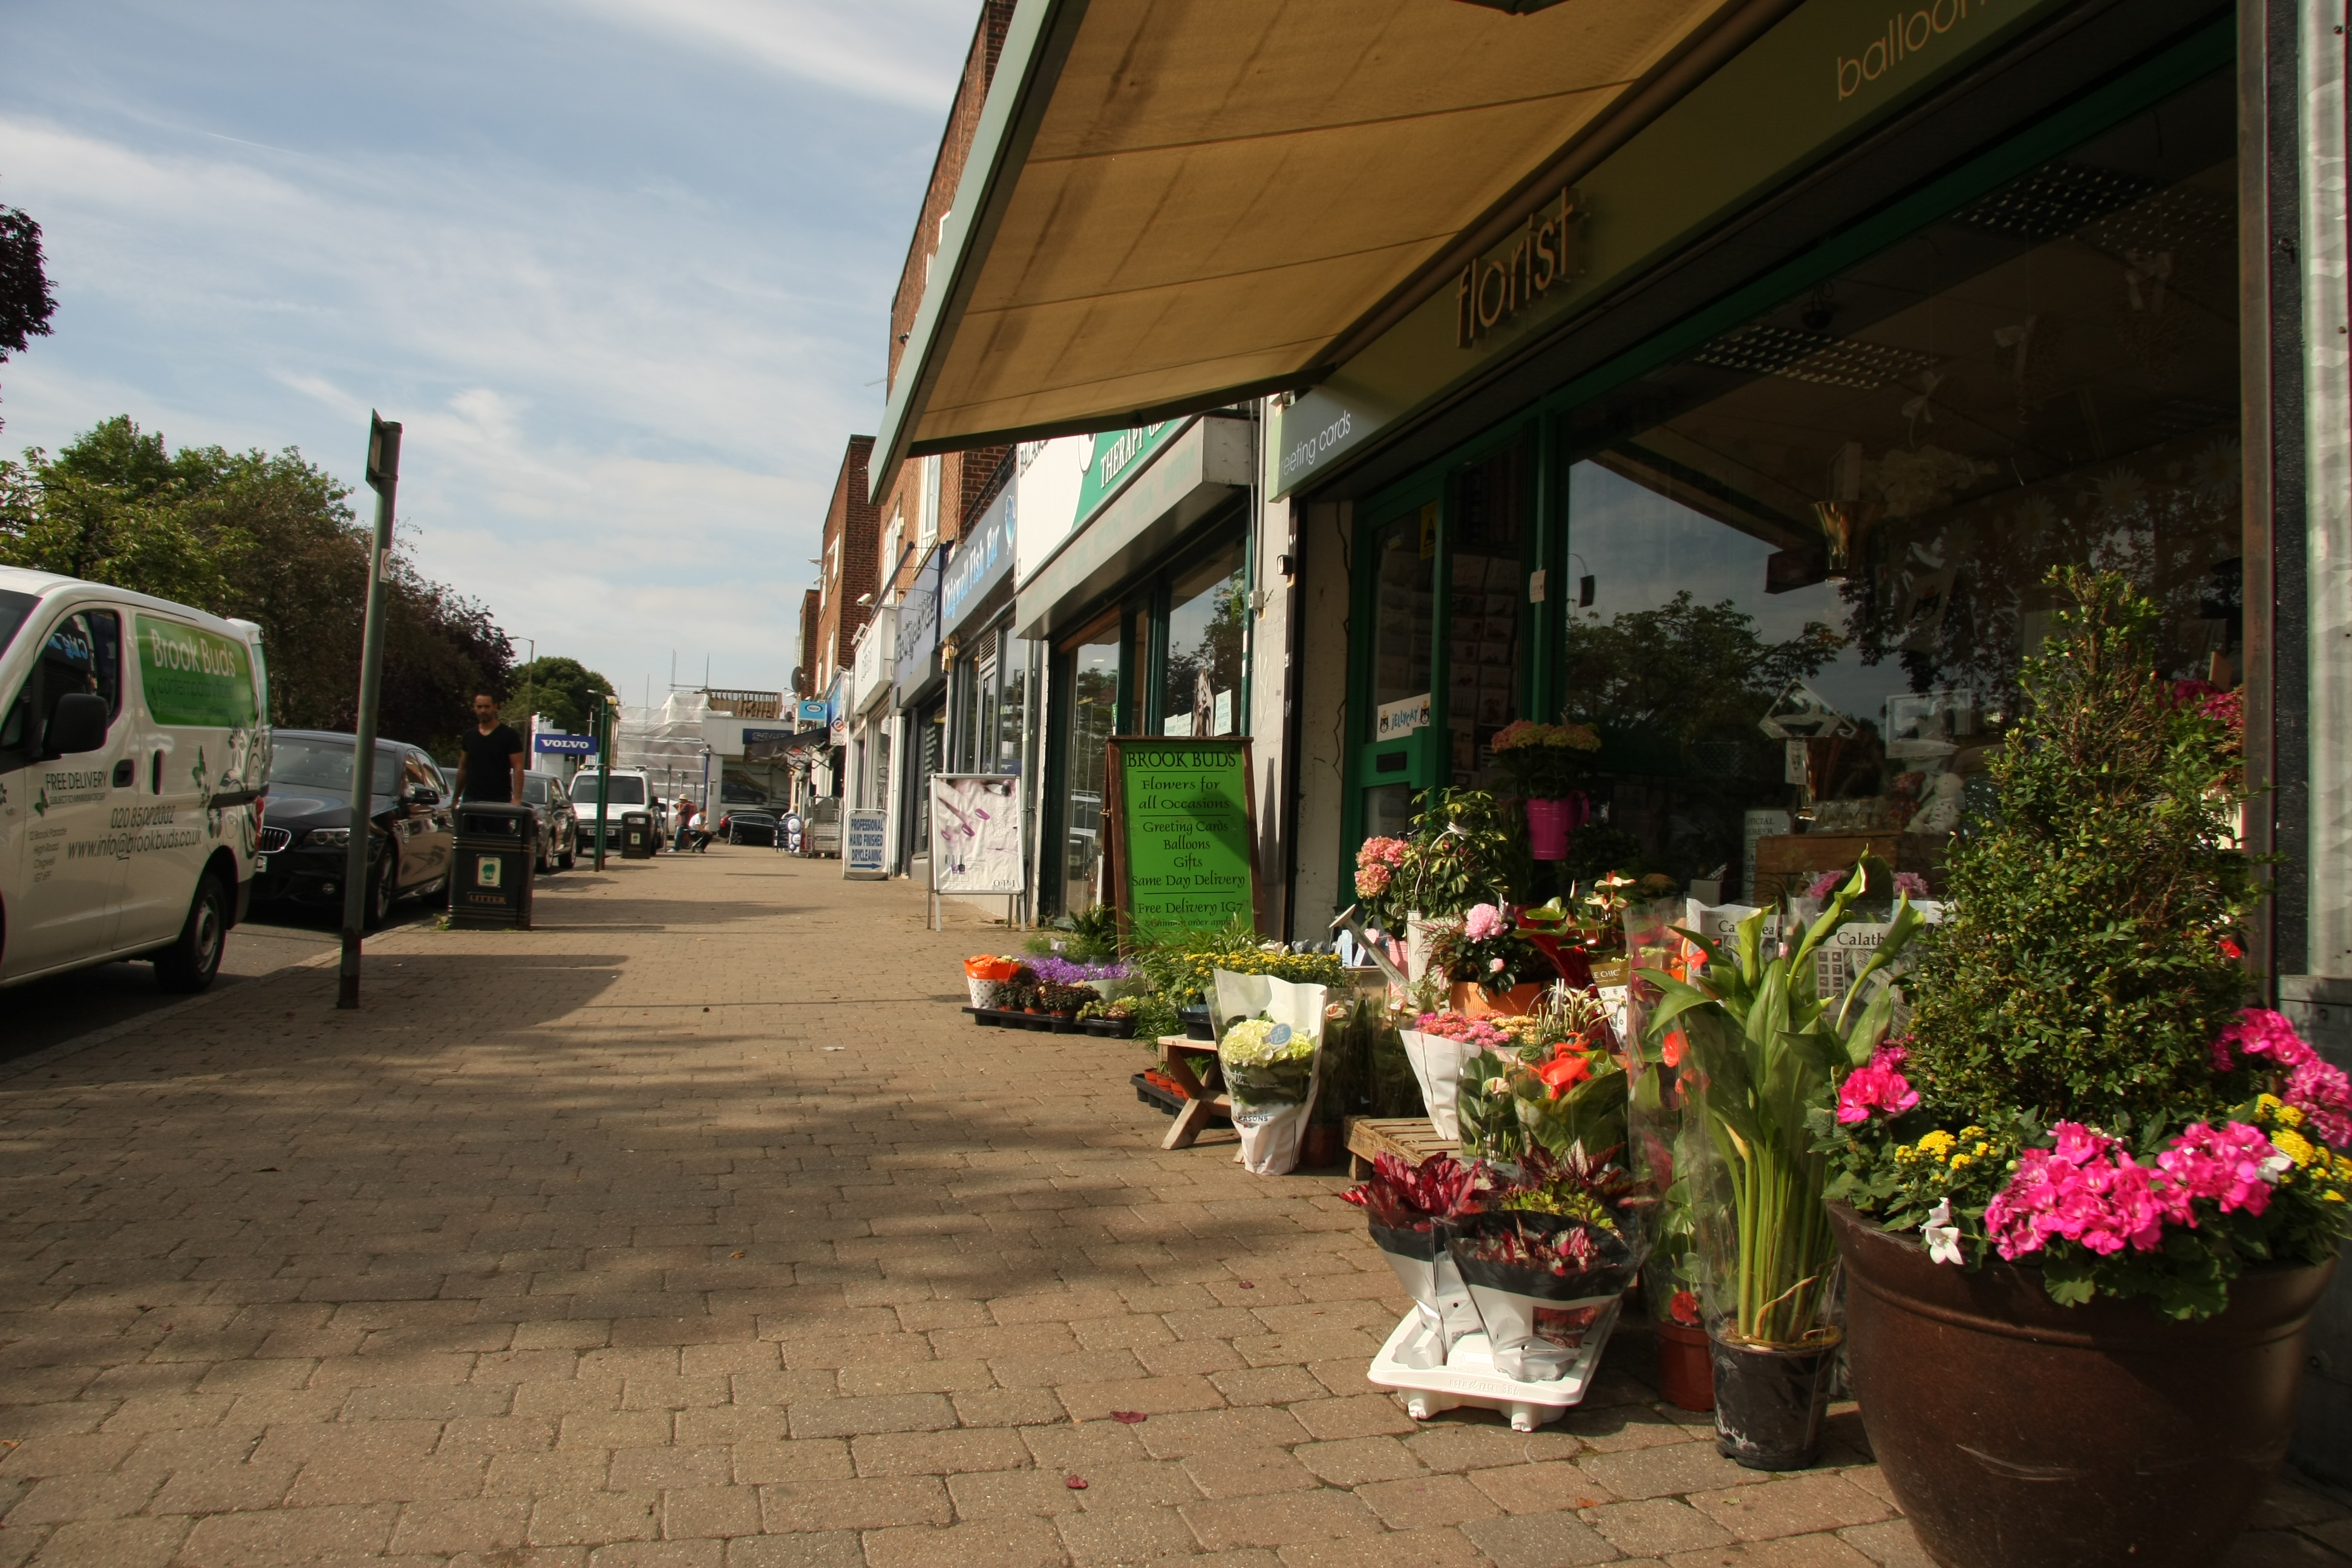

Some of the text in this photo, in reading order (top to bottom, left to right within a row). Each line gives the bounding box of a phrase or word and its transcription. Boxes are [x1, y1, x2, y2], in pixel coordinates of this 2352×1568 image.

[1837, 0, 1986, 102] balloo
[1455, 187, 1573, 348] florist
[1100, 427, 1144, 489] THERAPY
[1273, 410, 1351, 488] greeting cards
[943, 525, 1000, 619] Chigwell Fish Bar
[151, 628, 236, 678] Brook Buds
[541, 739, 589, 749] VOLVO
[1126, 751, 1236, 768] BROOK BUDS
[45, 771, 108, 790] FREE DELIVERY
[1142, 775, 1220, 793] Flowers for
[1138, 795, 1230, 809] all Occasions
[111, 808, 130, 829] 020
[152, 805, 176, 825] 2002
[851, 818, 884, 831] PROFESSIONAL
[34, 829, 49, 840] Brook
[50, 826, 67, 837] Parade
[1143, 820, 1229, 836] Greeting Cards
[68, 826, 202, 860] www.info@brookbuds.co.uk
[849, 834, 883, 847] HAND FINISHED
[1163, 835, 1210, 850] Balloons
[852, 849, 882, 862] DRYCLEANING
[1174, 852, 1203, 871] Gifts
[1132, 870, 1245, 889] Same Day Delivery
[1137, 898, 1243, 916] Free Delivery IG7
[1718, 920, 1774, 935] Caea
[1837, 932, 1886, 946] Calath
[1600, 969, 1620, 978] CHIC
